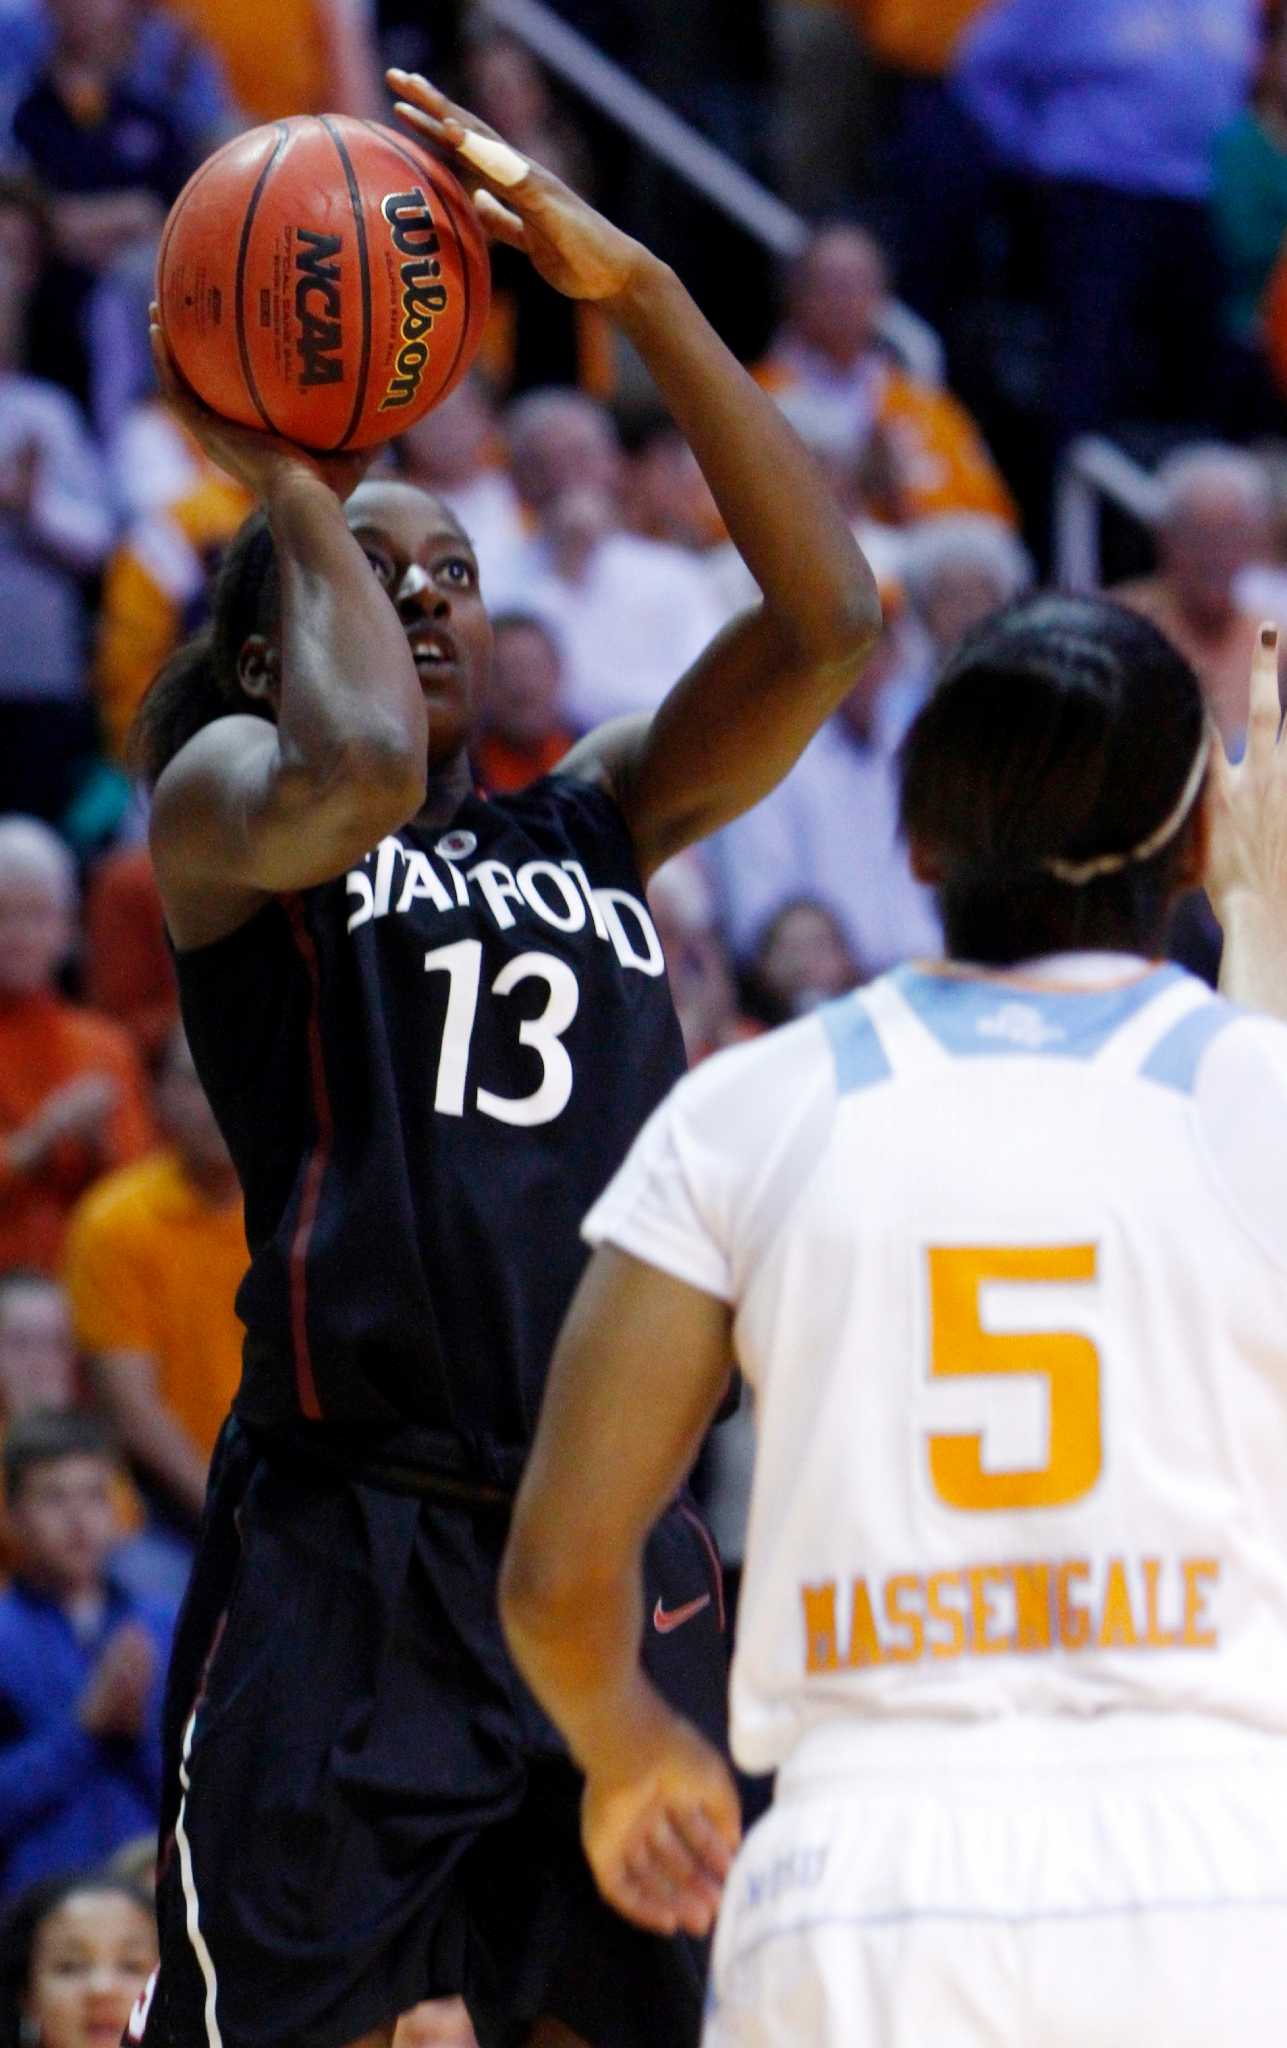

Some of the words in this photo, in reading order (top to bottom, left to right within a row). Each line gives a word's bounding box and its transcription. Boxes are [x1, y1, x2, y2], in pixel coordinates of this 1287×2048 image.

[296, 227, 343, 386] NCAA
[379, 186, 447, 412] Wilson
[424, 938, 580, 1128] 13
[926, 1242, 1103, 1513] 5
[801, 1556, 1220, 1678] MASSENGALE
